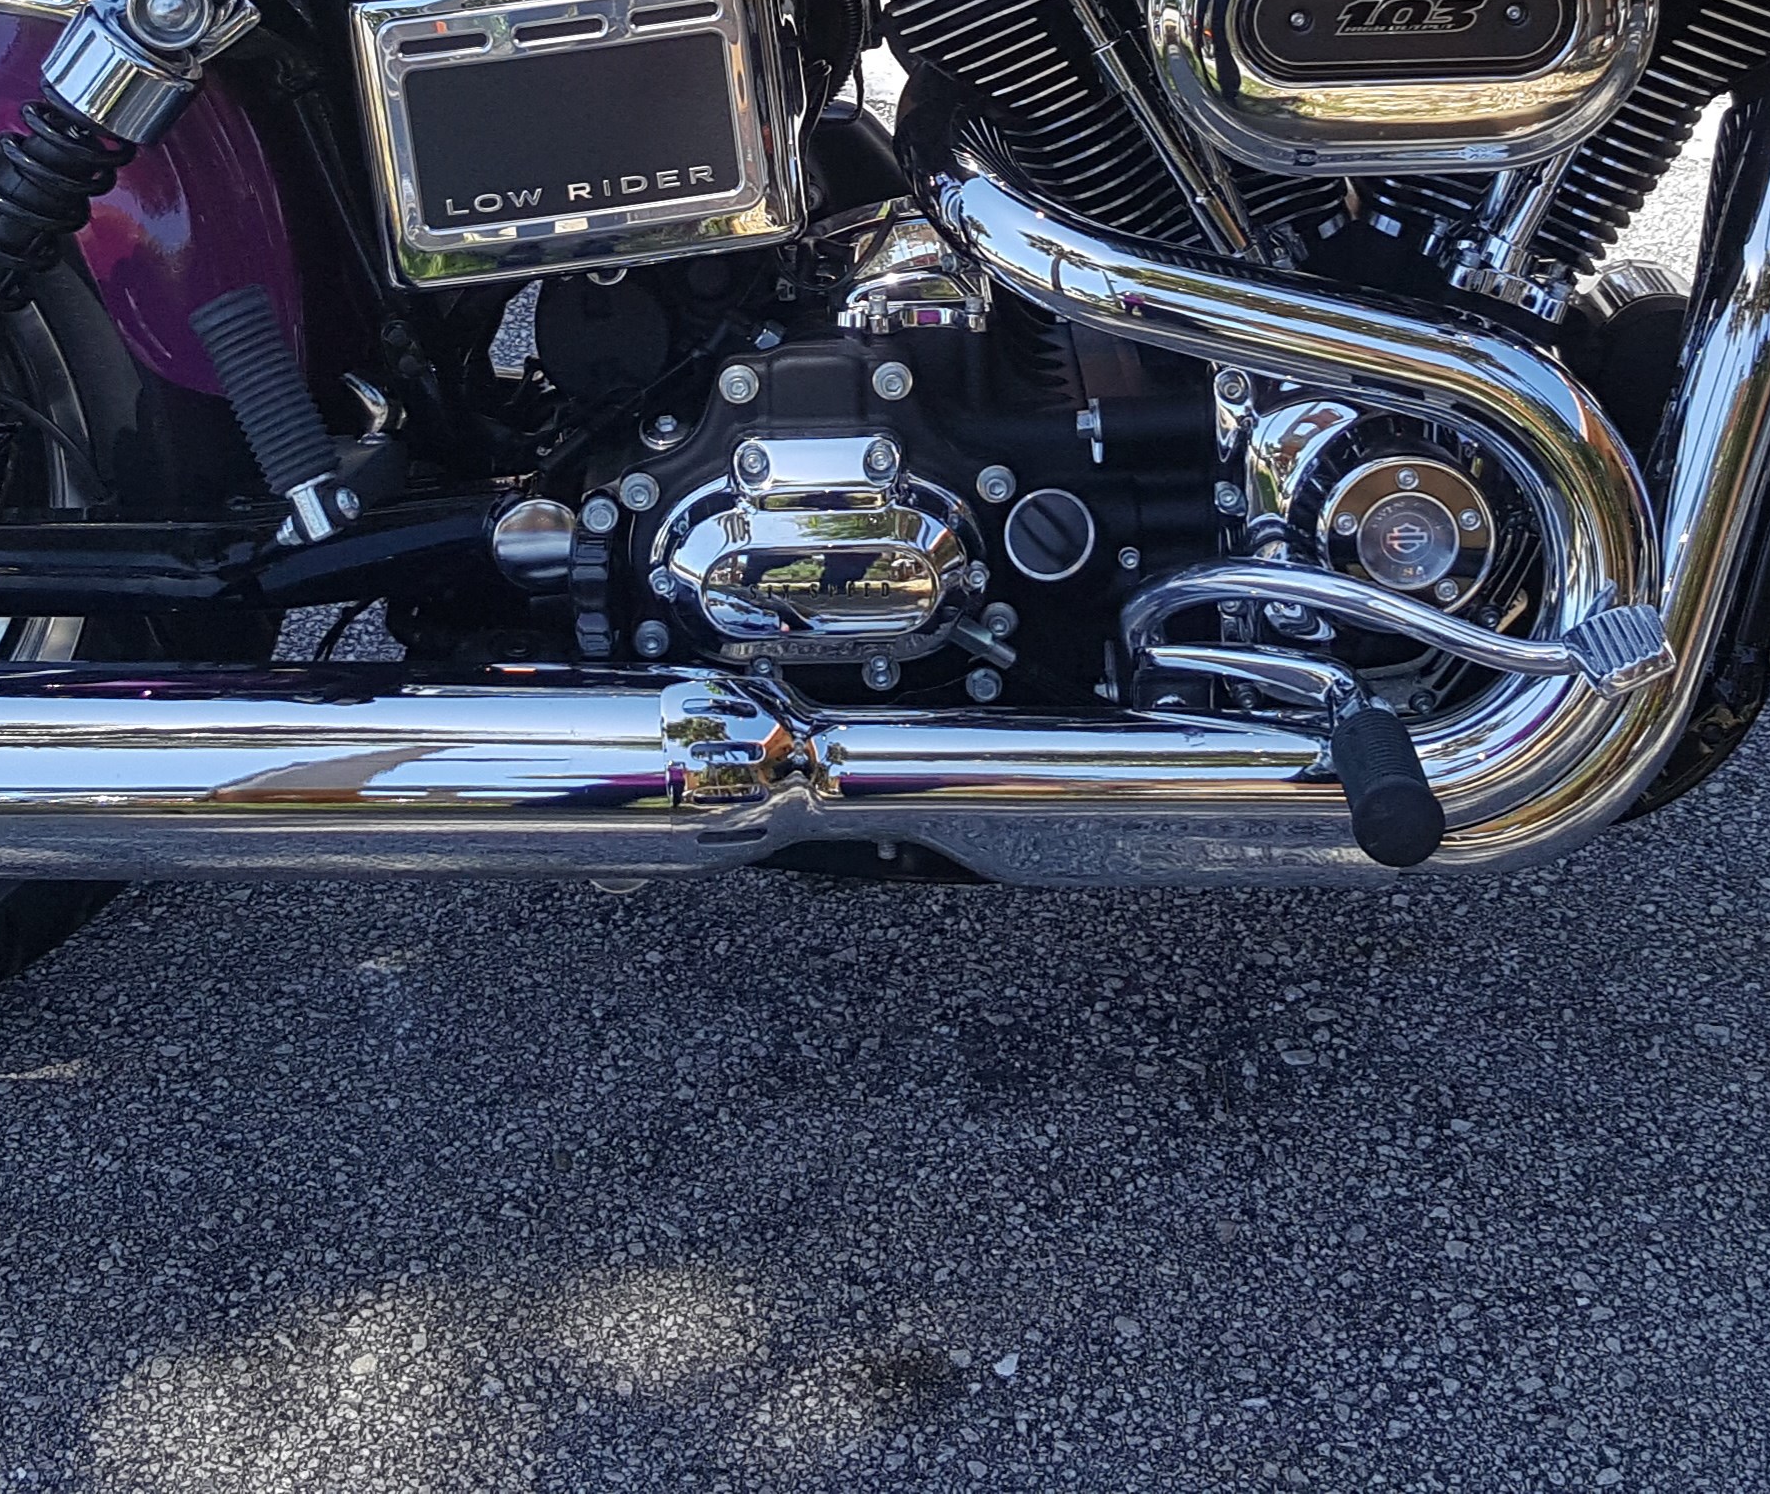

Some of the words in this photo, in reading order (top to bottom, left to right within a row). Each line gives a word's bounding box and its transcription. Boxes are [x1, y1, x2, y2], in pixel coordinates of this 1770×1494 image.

[445, 187, 543, 217] LOW
[567, 164, 716, 202] RIDER
[749, 583, 790, 601] SIX
[809, 580, 890, 599] SPEED
